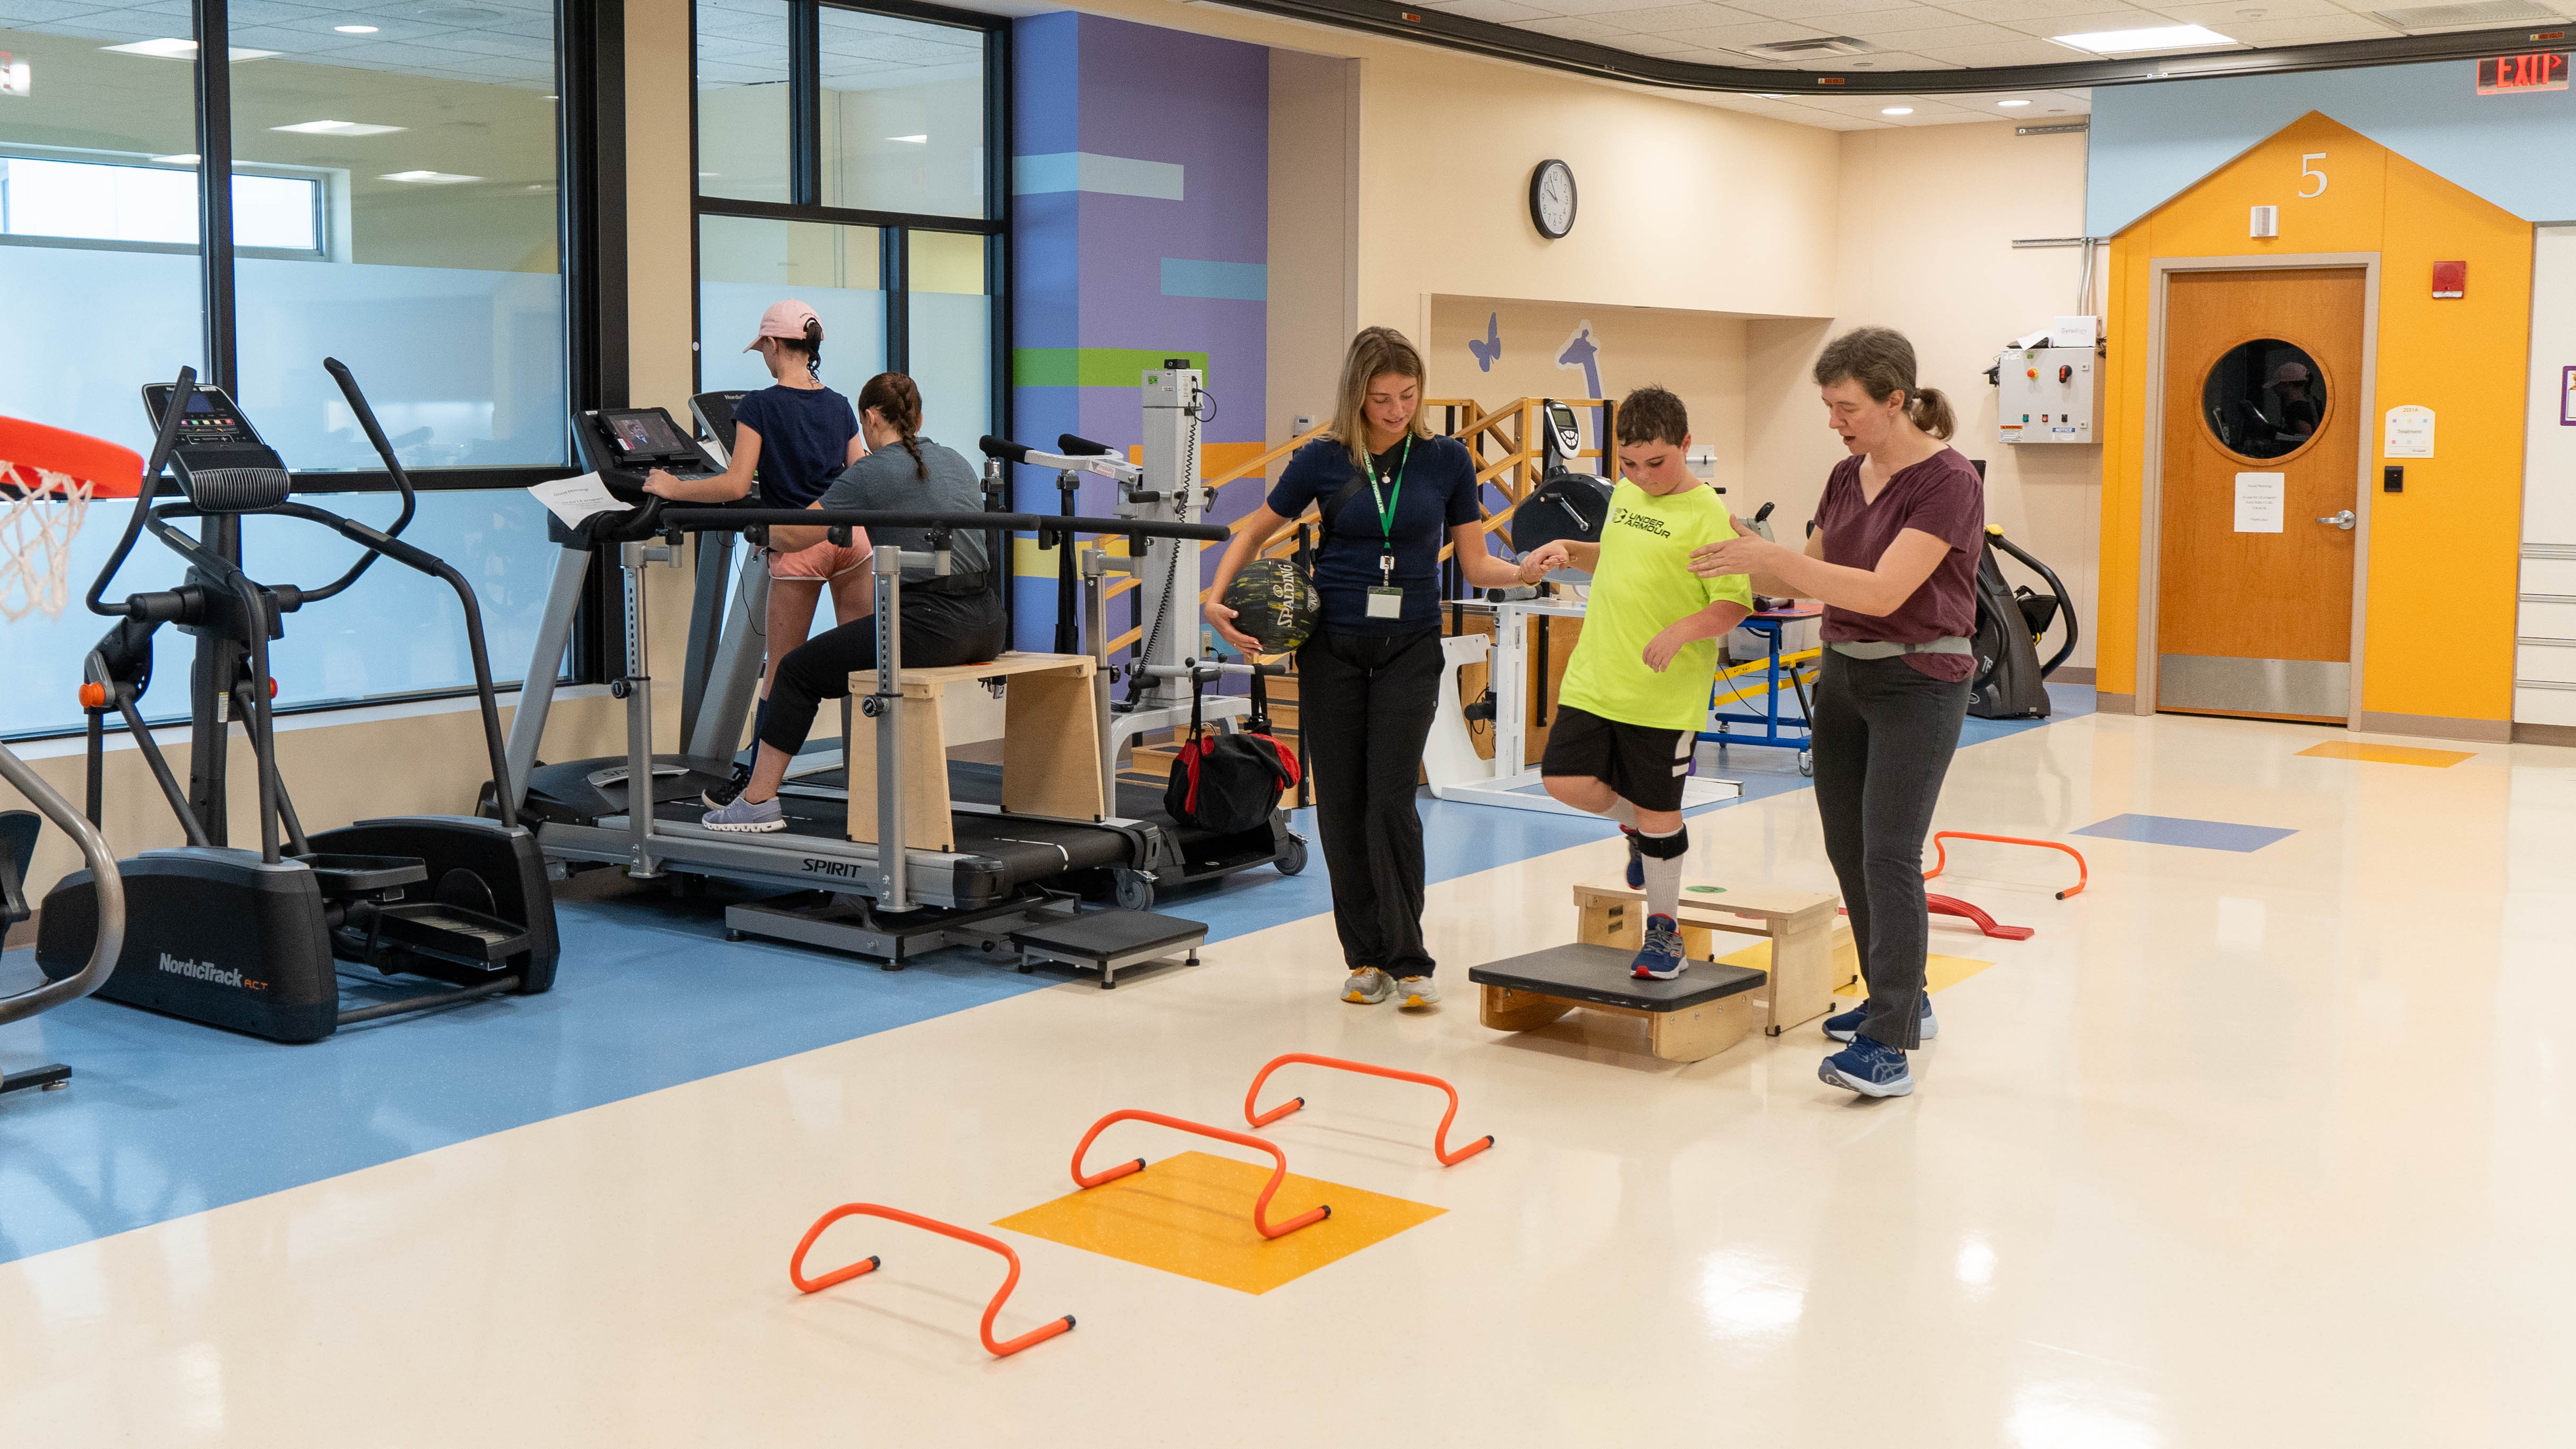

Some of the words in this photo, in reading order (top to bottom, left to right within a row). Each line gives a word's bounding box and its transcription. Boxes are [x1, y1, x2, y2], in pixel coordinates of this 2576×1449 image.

[2496, 53, 2551, 88] EXIT
[1543, 182, 1549, 191] 10
[1553, 171, 1558, 181] 12
[2298, 152, 2328, 199] 5
[1362, 448, 1373, 473] BLYTHED
[1371, 479, 1385, 514] BLYTHEDALE
[1624, 519, 1671, 539] ARMOUR
[1629, 513, 1664, 528] UNDER
[1277, 564, 1295, 628] SPALDING
[801, 858, 862, 878] SPIRIT
[159, 952, 243, 988] NordicTrack
